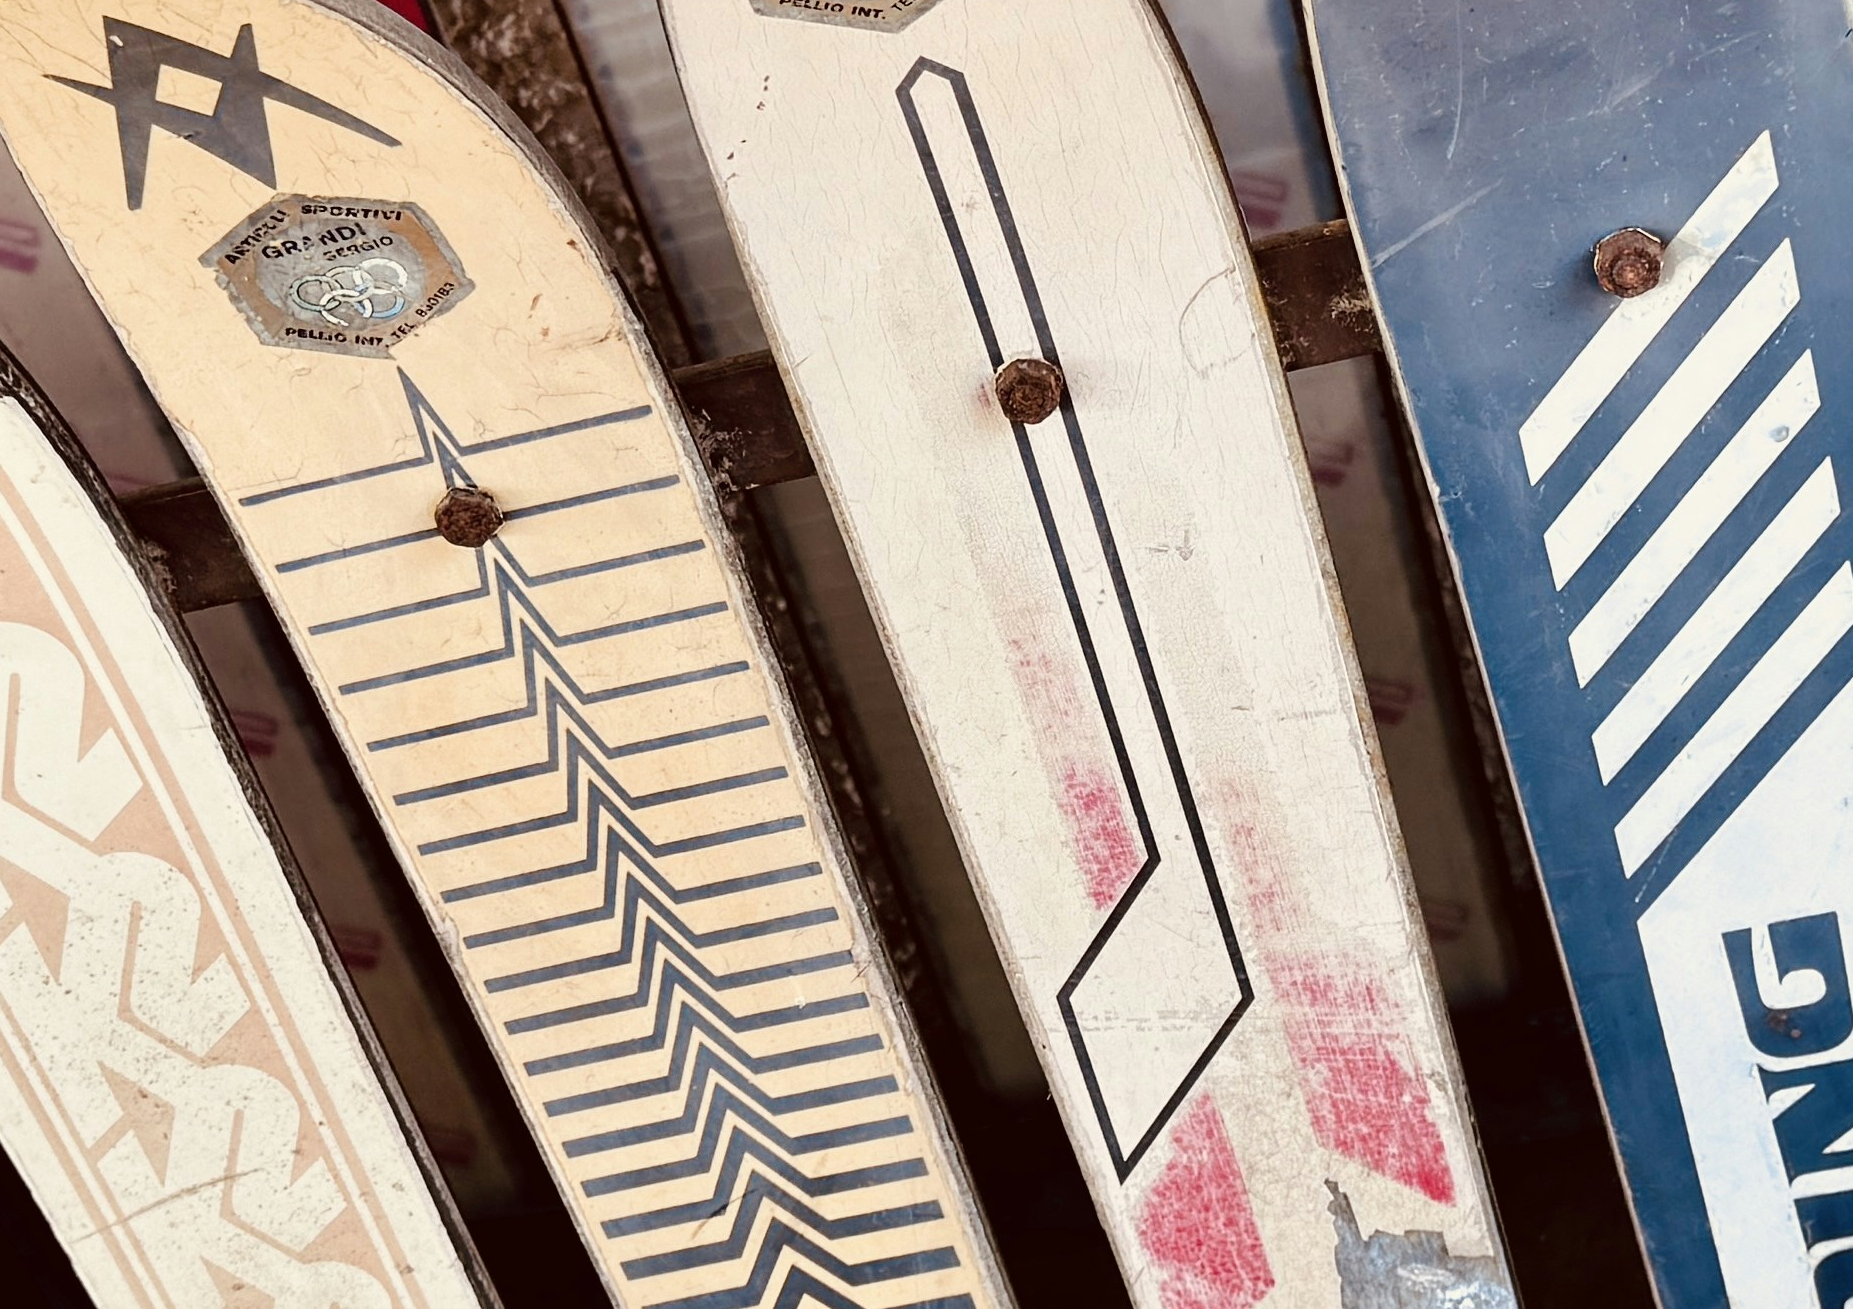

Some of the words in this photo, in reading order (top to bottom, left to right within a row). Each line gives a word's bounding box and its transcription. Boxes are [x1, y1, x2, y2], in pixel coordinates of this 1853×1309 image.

[300, 203, 403, 222] SPORTIVI
[261, 222, 368, 261] GRANDI
[323, 235, 395, 262] SERGIO
